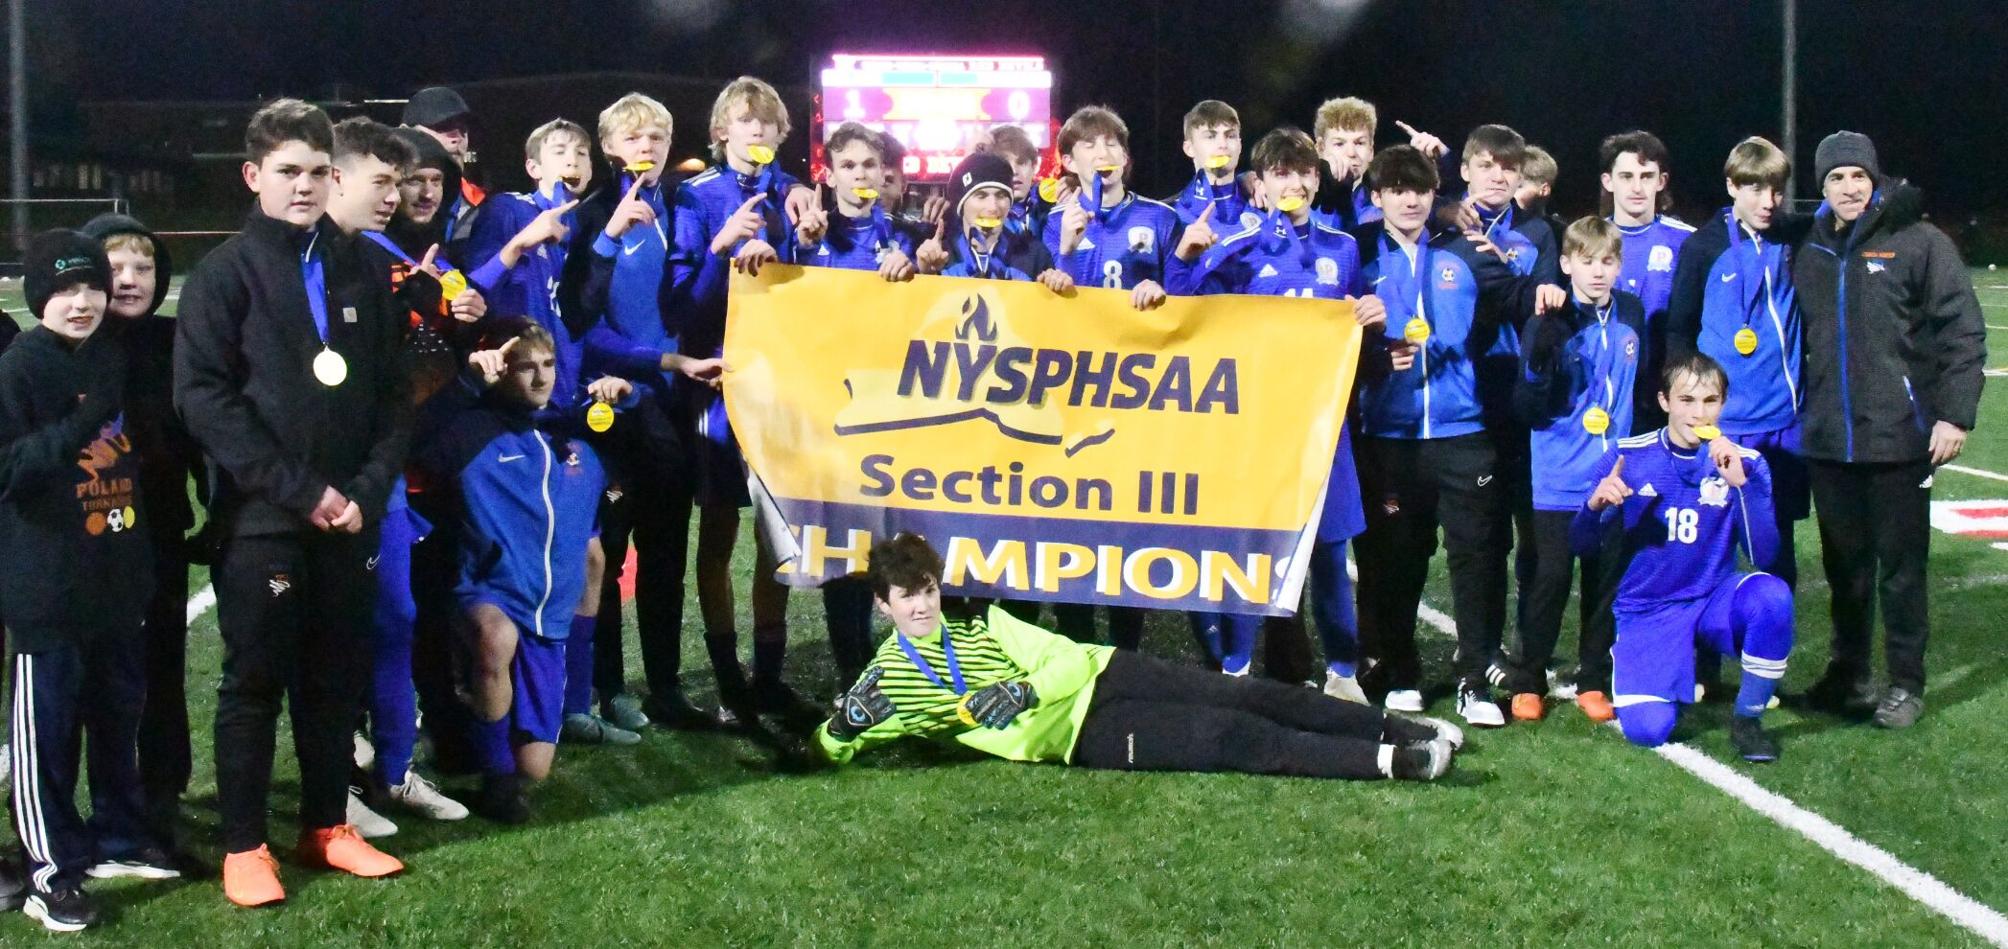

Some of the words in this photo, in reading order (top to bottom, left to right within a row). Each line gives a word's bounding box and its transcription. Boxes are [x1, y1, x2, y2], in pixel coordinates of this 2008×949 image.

[843, 89, 866, 118] 1
[1008, 90, 1030, 119] 0
[1103, 259, 1123, 288] 8
[897, 339, 1240, 415] NYSPHSAA
[859, 454, 1113, 510] Section
[1137, 470, 1199, 515] III
[1664, 507, 1699, 544] 18
[776, 523, 1292, 604] HMPION
